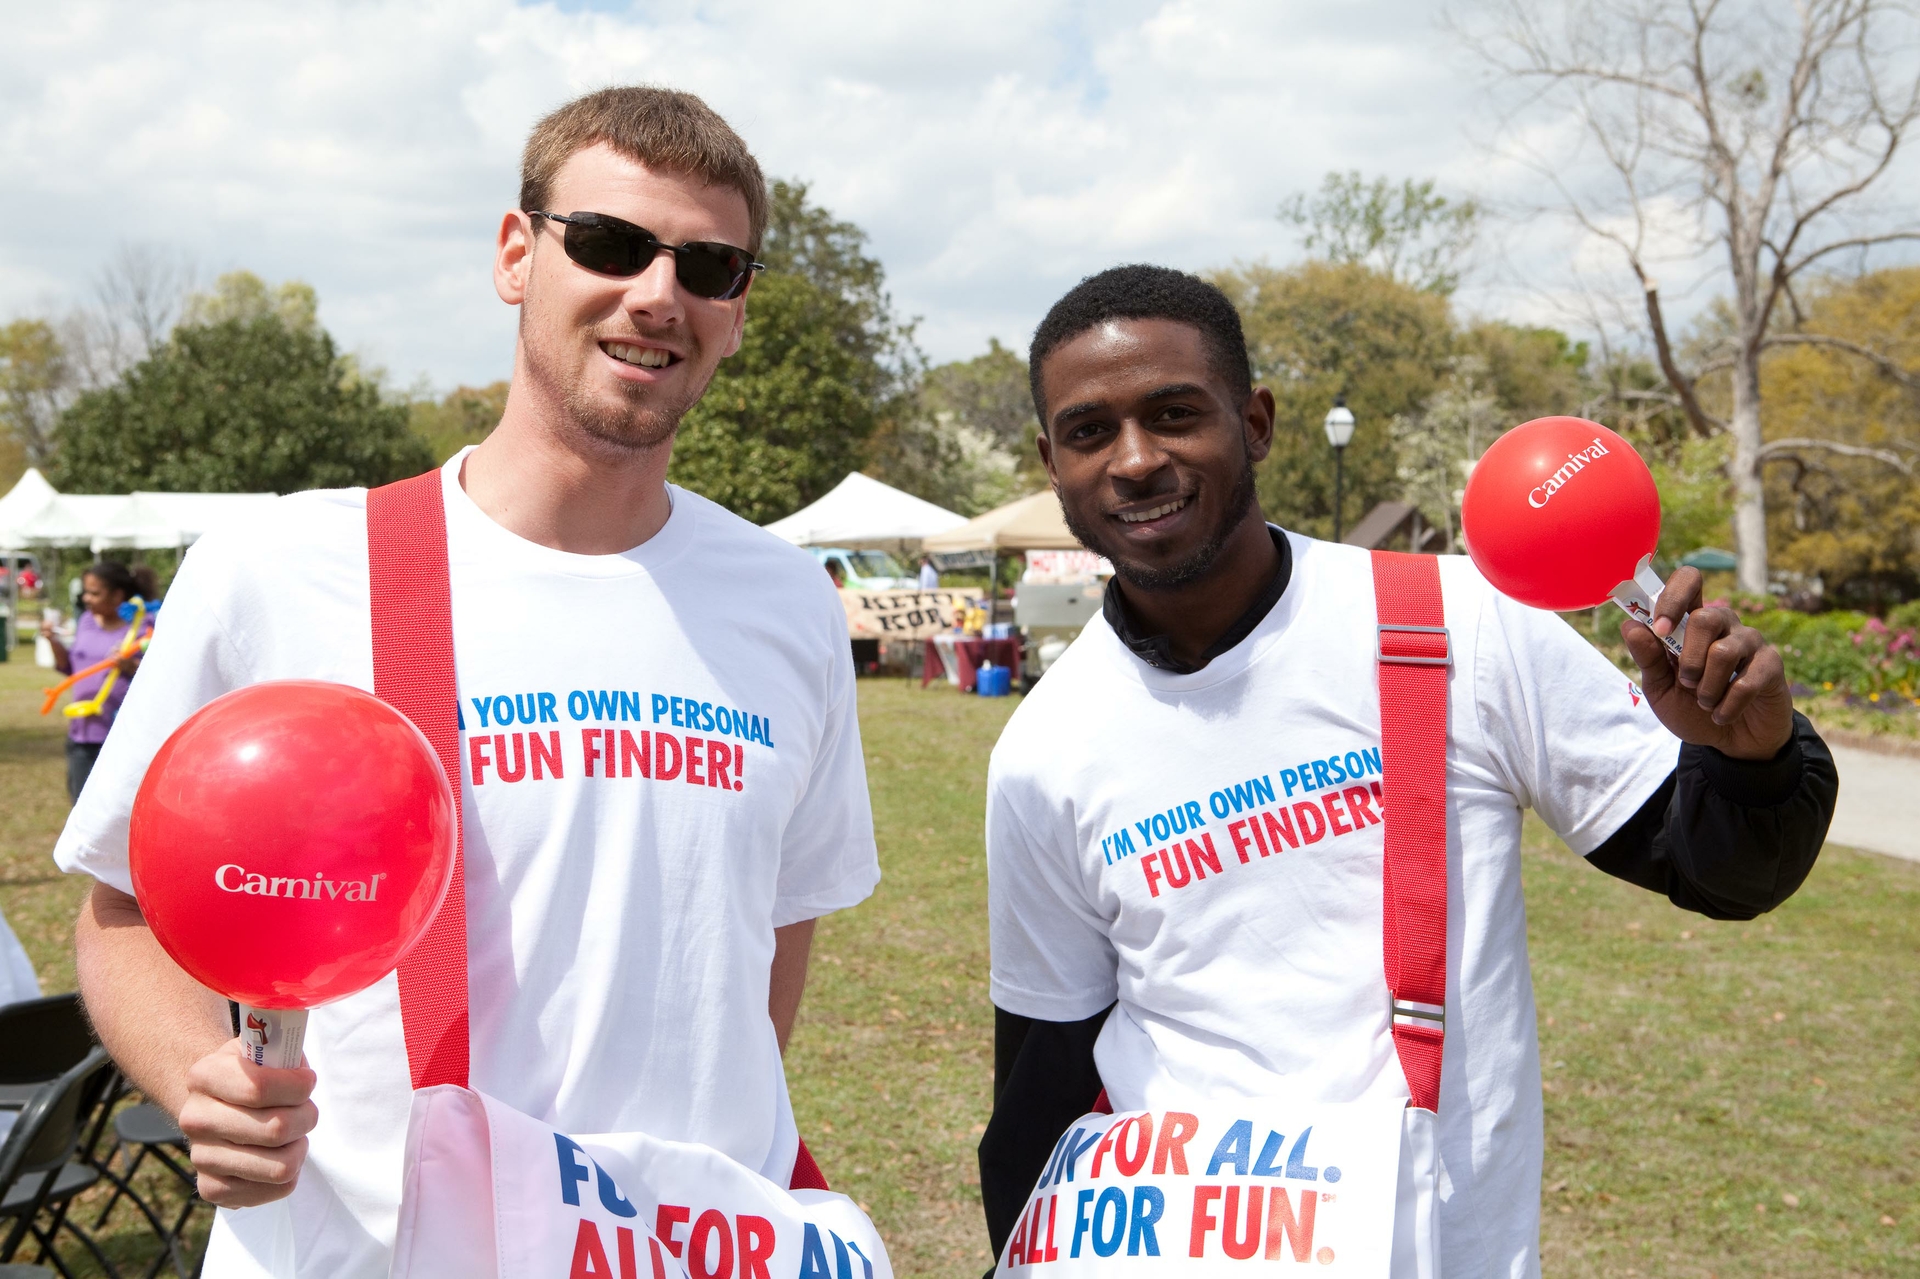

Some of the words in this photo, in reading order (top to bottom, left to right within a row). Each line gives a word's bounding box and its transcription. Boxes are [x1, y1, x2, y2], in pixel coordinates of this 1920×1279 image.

[1528, 437, 1610, 509] Carnival
[860, 593, 975, 610] KETT
[877, 608, 952, 630] KOR
[471, 691, 559, 728] YOUR
[567, 690, 642, 722] OWN
[651, 693, 775, 749] PERSONAL
[468, 730, 564, 786] FUN
[581, 728, 744, 792] FINDER!
[1101, 828, 1137, 866] I'M
[1135, 801, 1206, 847] YOUR
[1209, 775, 1277, 820] OWN
[1279, 746, 1383, 797] PERSON
[1140, 832, 1224, 898] FUN
[1227, 781, 1385, 865] FINDER!
[214, 863, 381, 902] Carnival
[1090, 1111, 1200, 1179] FOR
[1205, 1119, 1342, 1184] ALL.
[656, 1203, 776, 1279] FOR
[1008, 1194, 1058, 1268] ALL
[1069, 1185, 1166, 1259] FOR
[1188, 1185, 1335, 1266] FUN.
